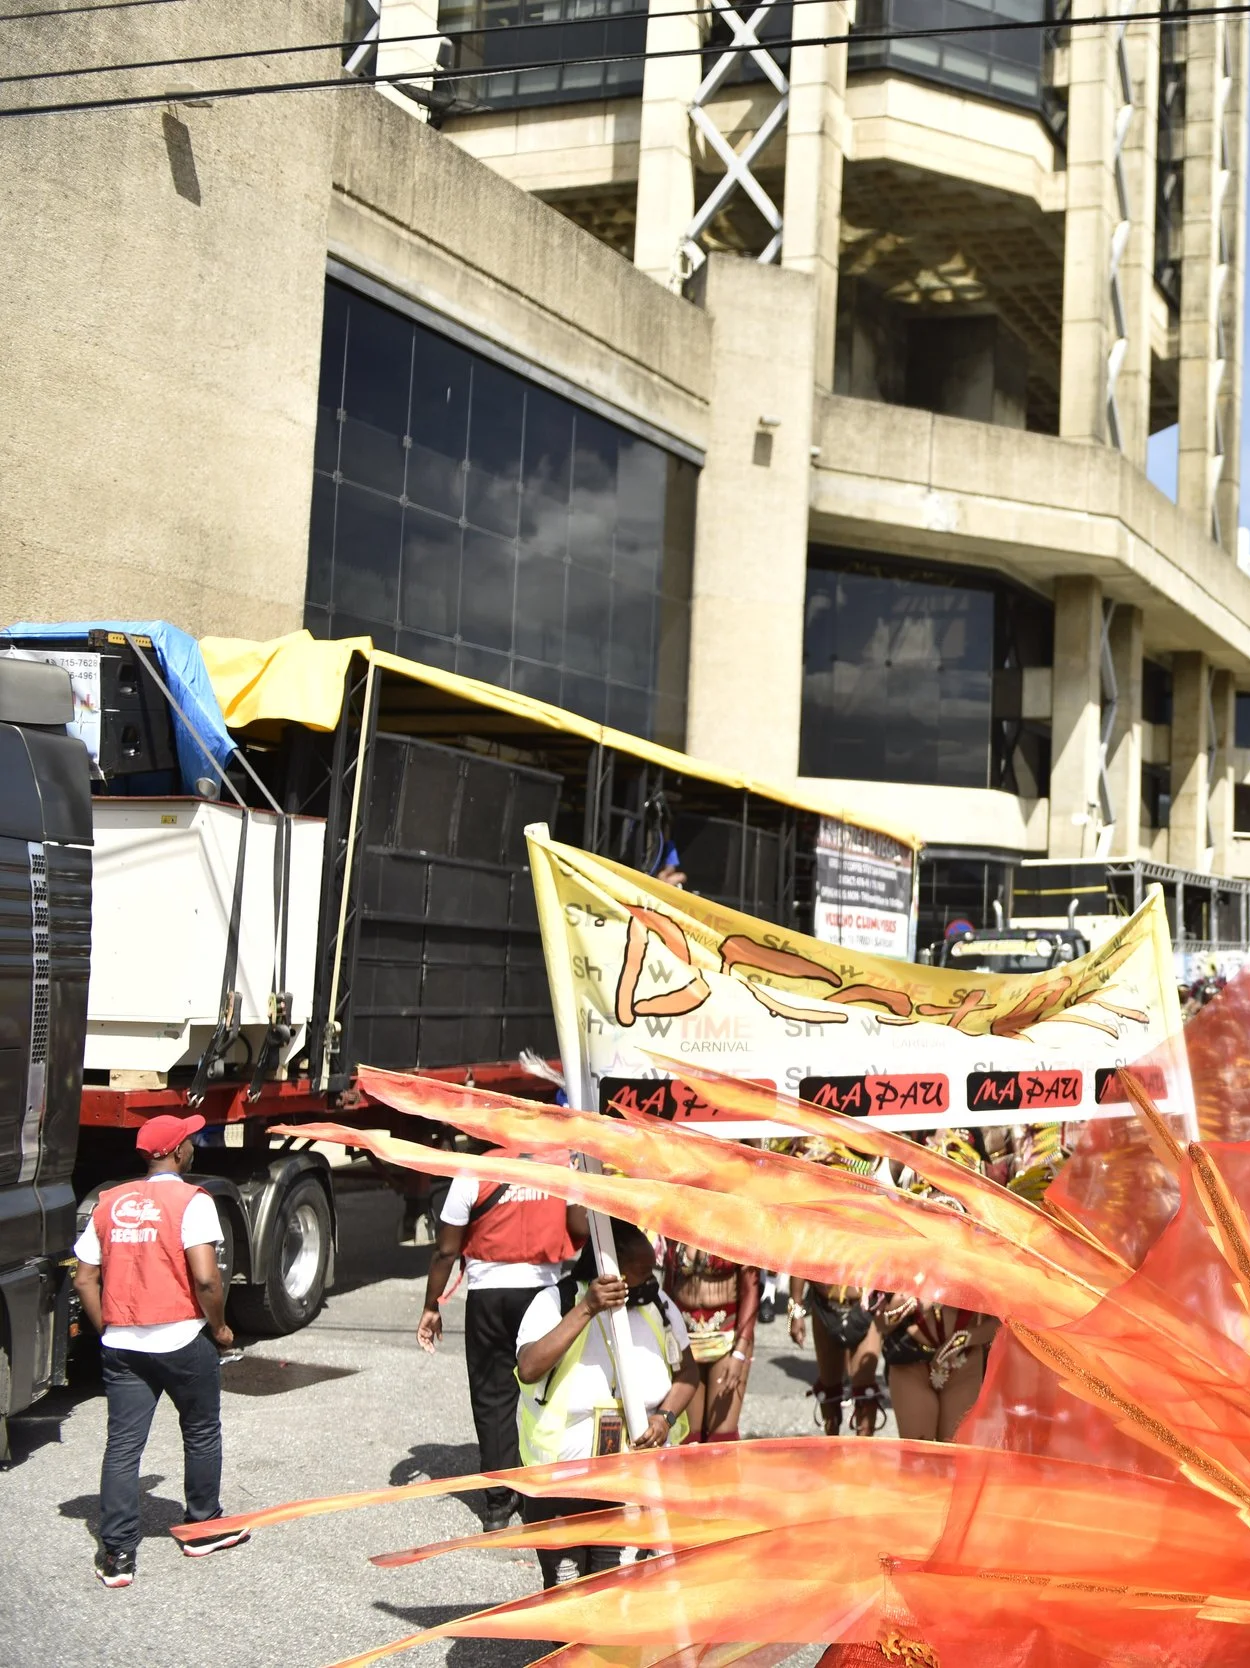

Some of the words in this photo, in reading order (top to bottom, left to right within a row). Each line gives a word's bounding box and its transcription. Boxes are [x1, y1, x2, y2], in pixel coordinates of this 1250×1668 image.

[60, 658, 98, 667] 715-7628
[680, 1041, 754, 1053] CARNIVAL
[812, 1082, 863, 1111] MA
[875, 1080, 943, 1110] PAU
[972, 1078, 1016, 1106] MA
[1027, 1076, 1079, 1104] PAU
